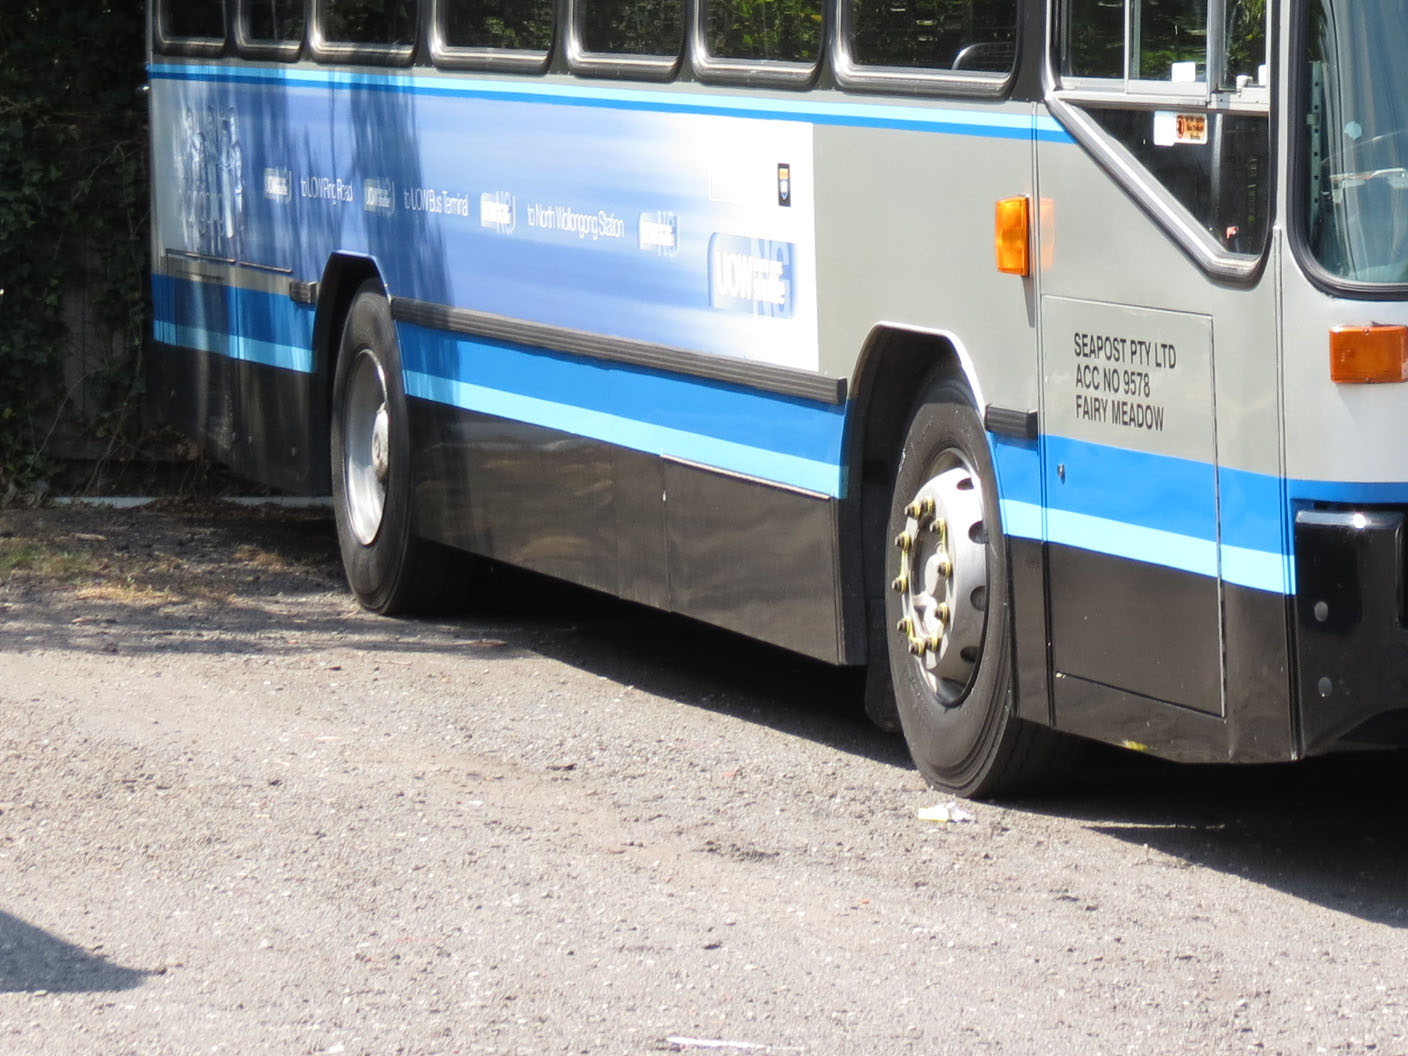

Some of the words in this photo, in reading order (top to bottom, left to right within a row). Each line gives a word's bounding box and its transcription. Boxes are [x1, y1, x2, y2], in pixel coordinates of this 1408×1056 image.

[714, 249, 752, 299] UOW
[1074, 332, 1126, 363] SEAPOST
[1130, 340, 1151, 366] PTY
[1155, 343, 1177, 369] LTD
[1076, 364, 1100, 390] ACC
[1103, 367, 1120, 393] NO
[1123, 370, 1151, 398] 9578
[1076, 394, 1108, 423] FAIRY
[1112, 400, 1165, 432] MEADOW
